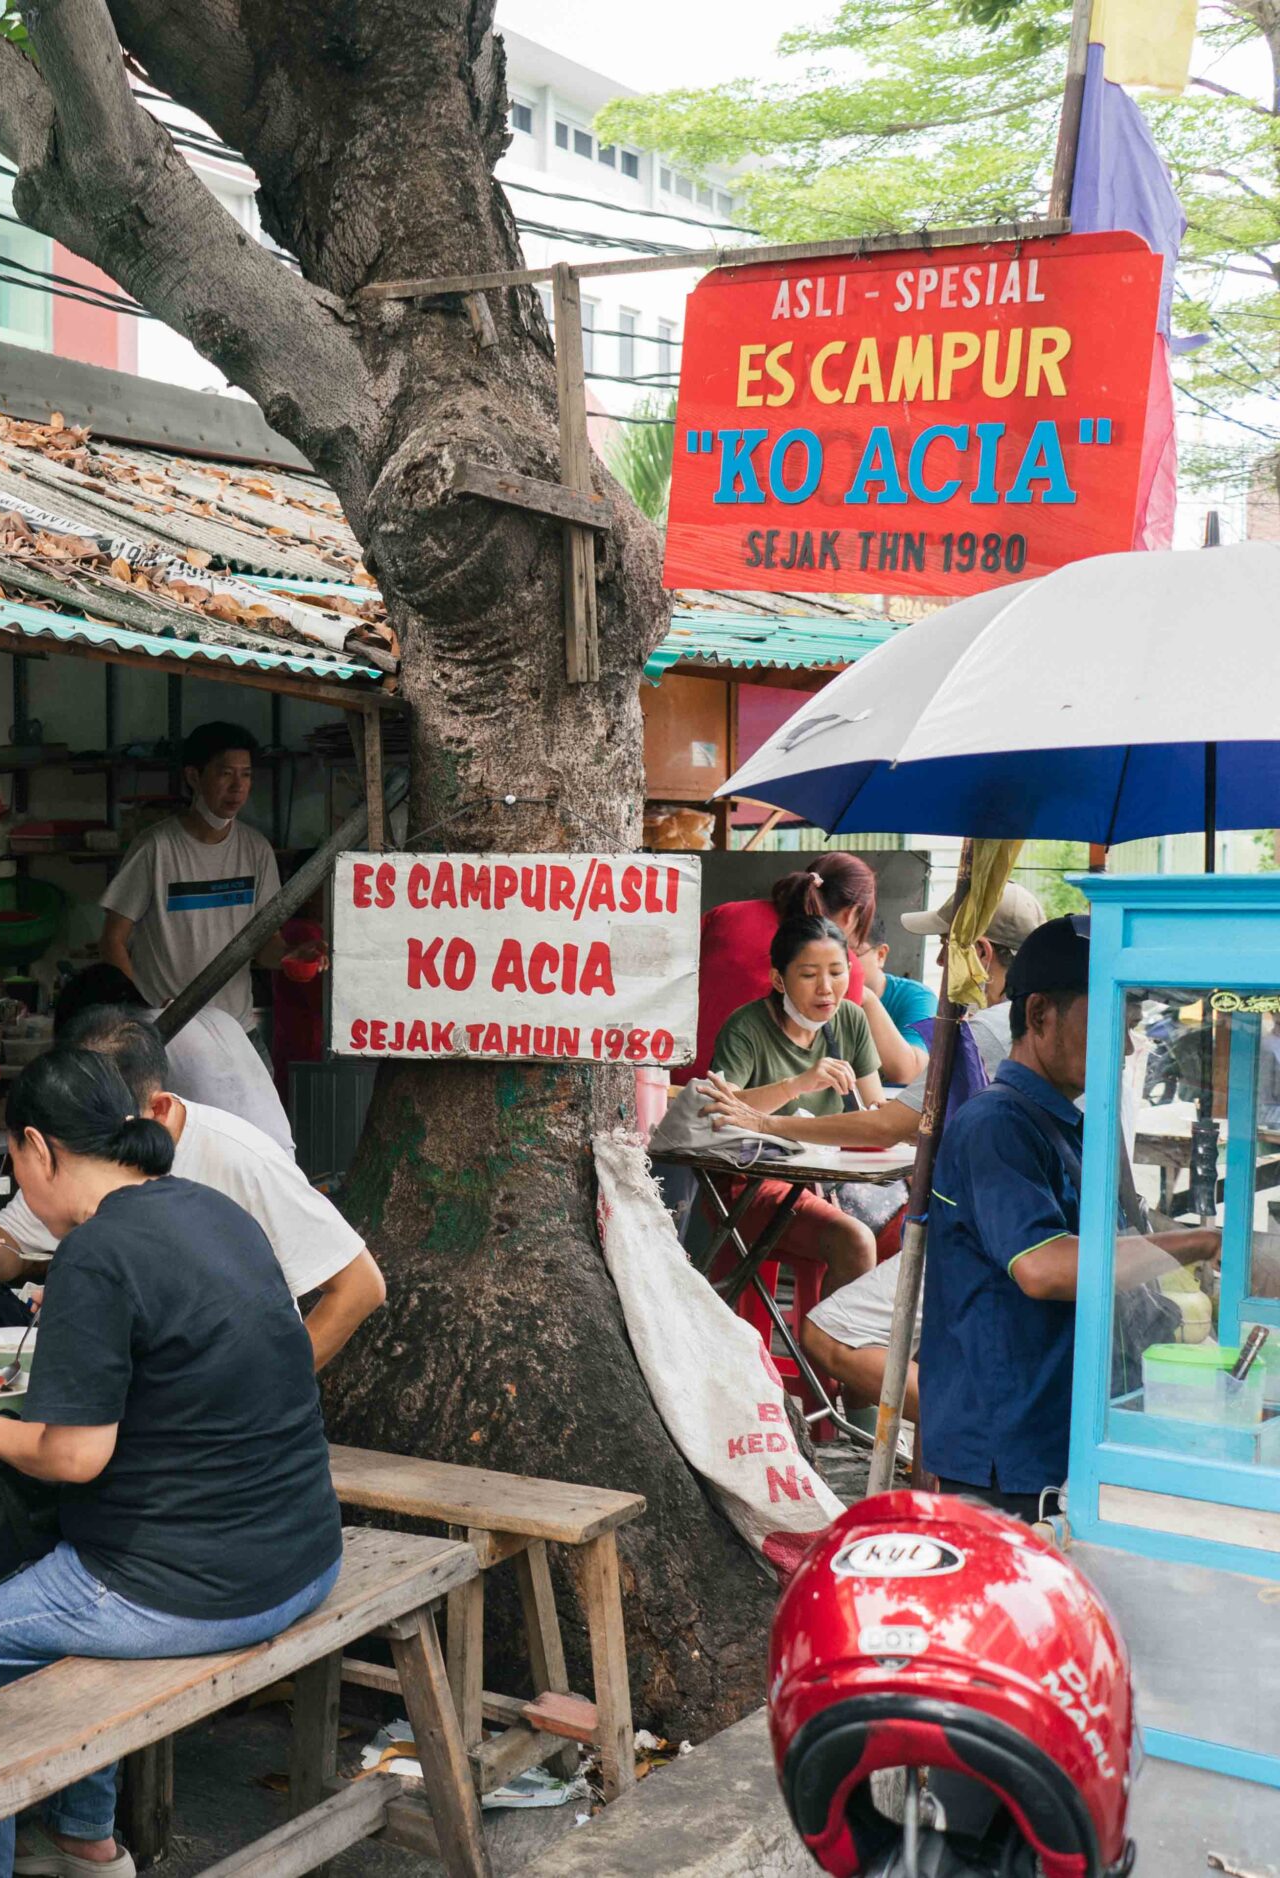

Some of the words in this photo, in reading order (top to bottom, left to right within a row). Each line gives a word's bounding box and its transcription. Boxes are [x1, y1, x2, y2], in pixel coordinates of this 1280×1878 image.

[772, 275, 846, 320] ASLI
[893, 259, 1045, 312] SPESIAL
[736, 341, 796, 408] ES
[810, 326, 1072, 404] CAMPUR
[687, 427, 823, 505] "KO
[844, 417, 1113, 505] ACIA"
[745, 529, 841, 570] SEJAK
[858, 531, 927, 572] THN
[941, 532, 1027, 574] 1980
[353, 862, 396, 909] ES
[407, 858, 680, 921] CAMPUR/ASLI
[407, 936, 477, 991] KO
[491, 938, 616, 997] ACIA
[350, 1018, 456, 1053] SEJAK
[465, 1023, 581, 1057] TAHUN
[591, 1028, 675, 1061] 1980
[1059, 1660, 1105, 1717] DJ
[1040, 1669, 1116, 1779] MARU
